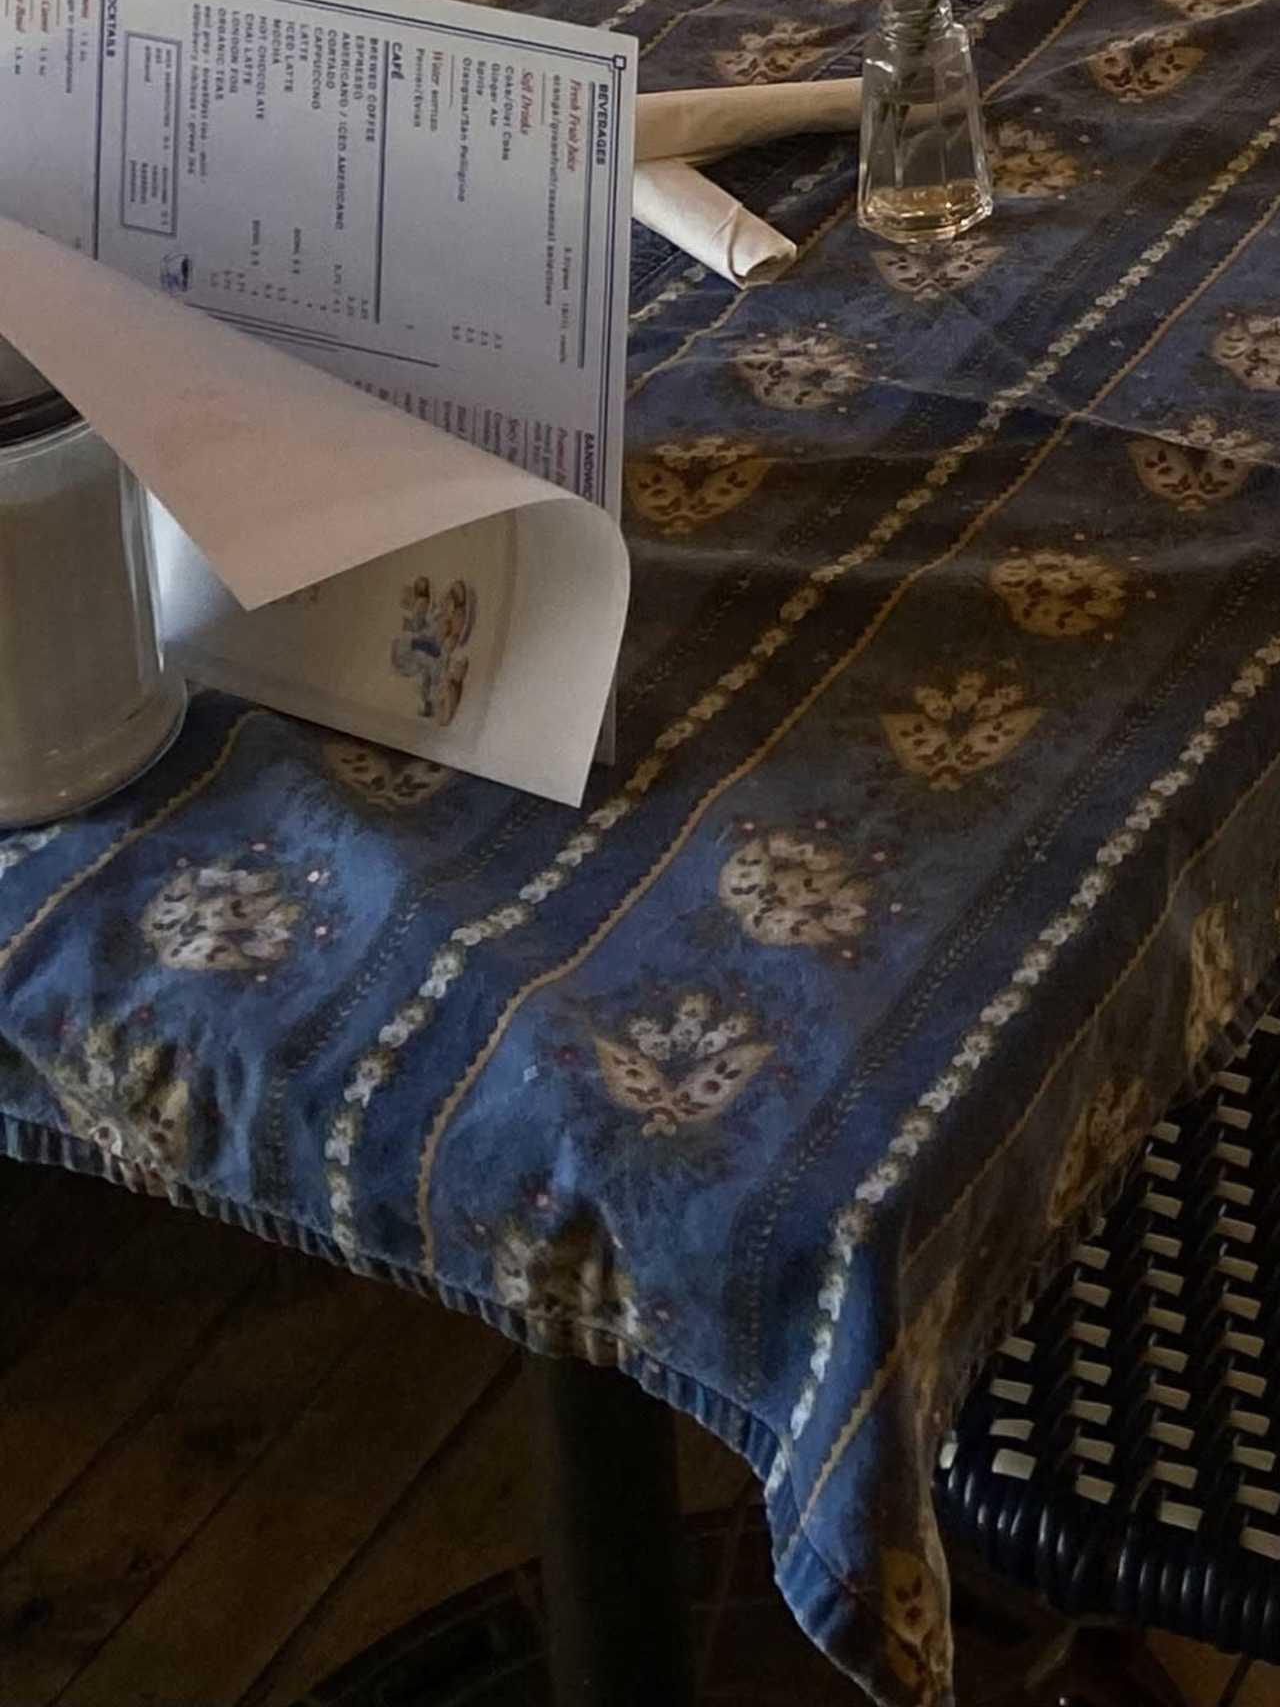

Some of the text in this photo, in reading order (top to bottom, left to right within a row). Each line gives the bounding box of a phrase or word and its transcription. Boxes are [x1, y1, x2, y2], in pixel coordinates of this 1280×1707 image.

[214, 7, 226, 101] ORGANIC TEAS
[228, 10, 240, 94] LONDON FOG
[242, 13, 254, 85] CHAI LATTE
[256, 16, 268, 43] HOT
[271, 19, 282, 65] MOCHA
[284, 21, 295, 93] ICED LATTE
[299, 24, 309, 62] LATTE
[326, 30, 337, 90] CORTADO
[390, 42, 405, 80] CAFÉ
[255, 45, 266, 120] CHOCOLATE
[311, 27, 323, 110] CAPPUCCINO
[338, 32, 350, 107] AMERICANO
[353, 35, 365, 100] ESPRESSO
[367, 37, 379, 90] BREWED
[475, 60, 487, 96] Sprite
[489, 63, 501, 127] Ginger Ale
[337, 121, 347, 151] ICED
[365, 94, 377, 143] COFFEE
[501, 66, 515, 161] Coke/Diet Coke
[520, 69, 534, 136] Soft Drinks
[565, 79, 582, 171] Fresh Fruit Juice
[596, 84, 609, 165] BEVERAGES
[335, 155, 347, 231] AMERICANO
[583, 433, 595, 500] SANDWIC
